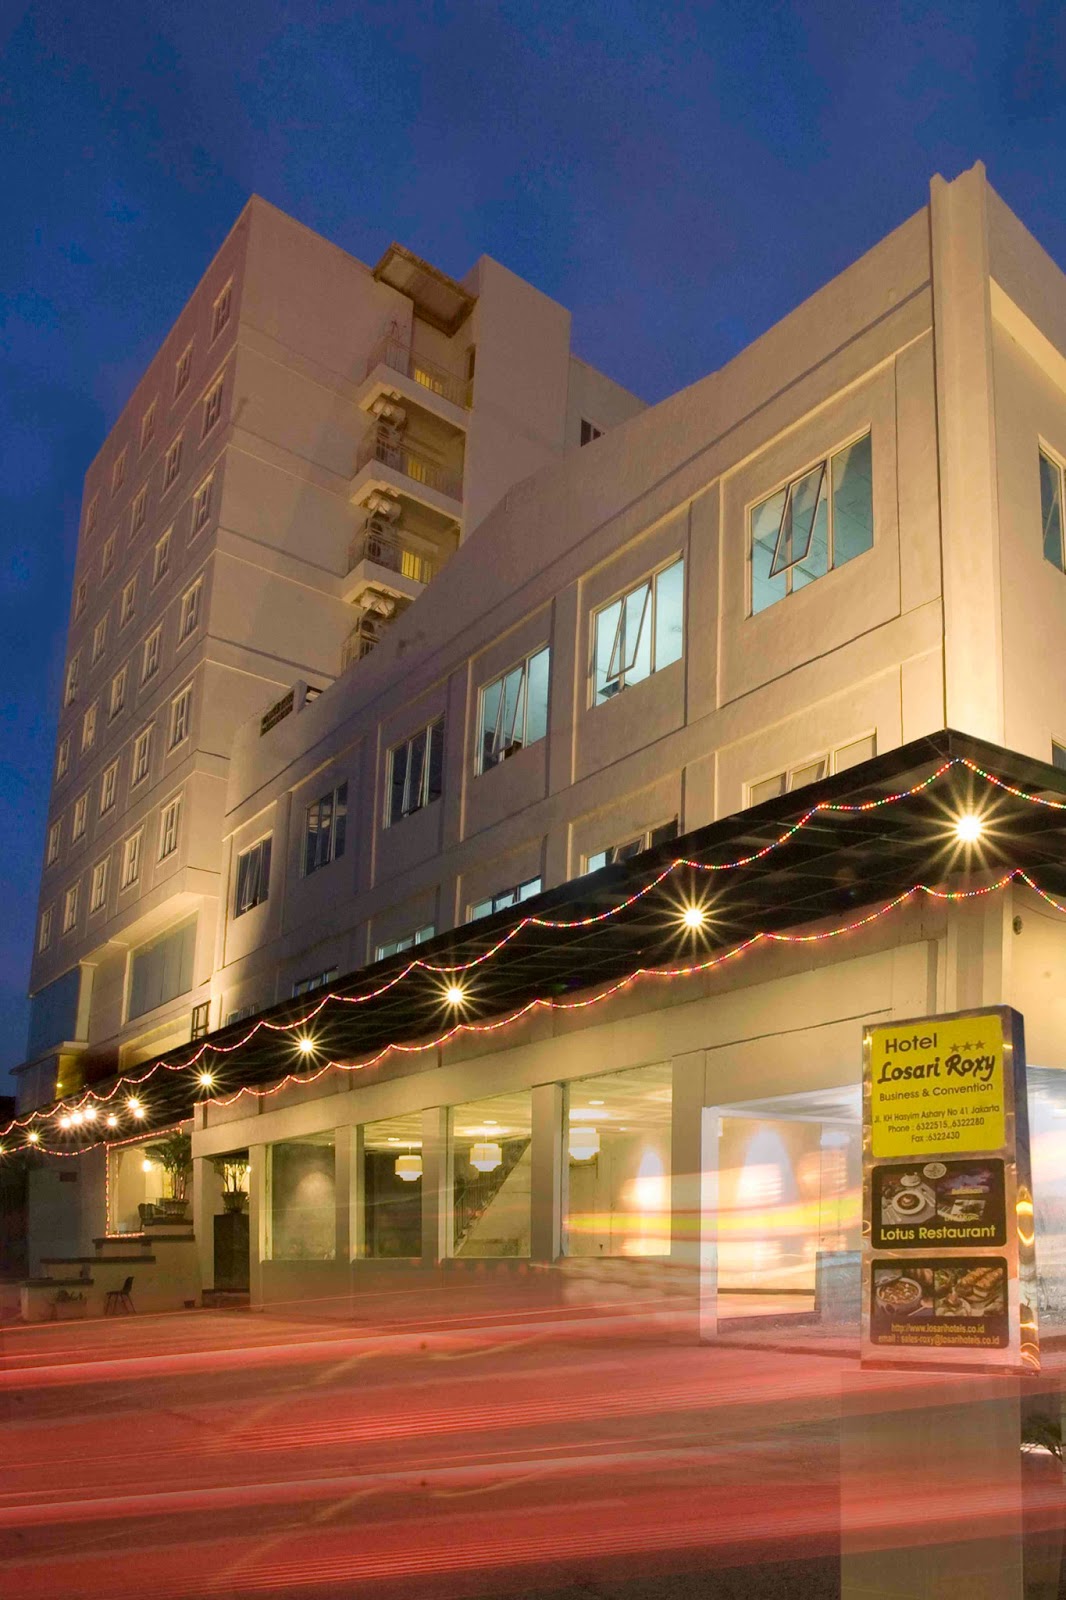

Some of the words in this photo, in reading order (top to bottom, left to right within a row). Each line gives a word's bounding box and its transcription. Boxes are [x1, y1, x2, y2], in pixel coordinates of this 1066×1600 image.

[885, 1033, 937, 1054] Hotel
[877, 1057, 941, 1084] Losari
[945, 1054, 995, 1082] Roxy
[879, 1090, 919, 1102] Business
[922, 1088, 930, 1097] &
[932, 1083, 993, 1096] Convention
[947, 1107, 958, 1116] No
[960, 1106, 968, 1115] 41
[971, 1104, 1000, 1114] Jakarta
[888, 1125, 910, 1133] Phone
[911, 1134, 924, 1143] Fax
[880, 1228, 915, 1241] Lotus
[919, 1225, 996, 1240] Restaurant
